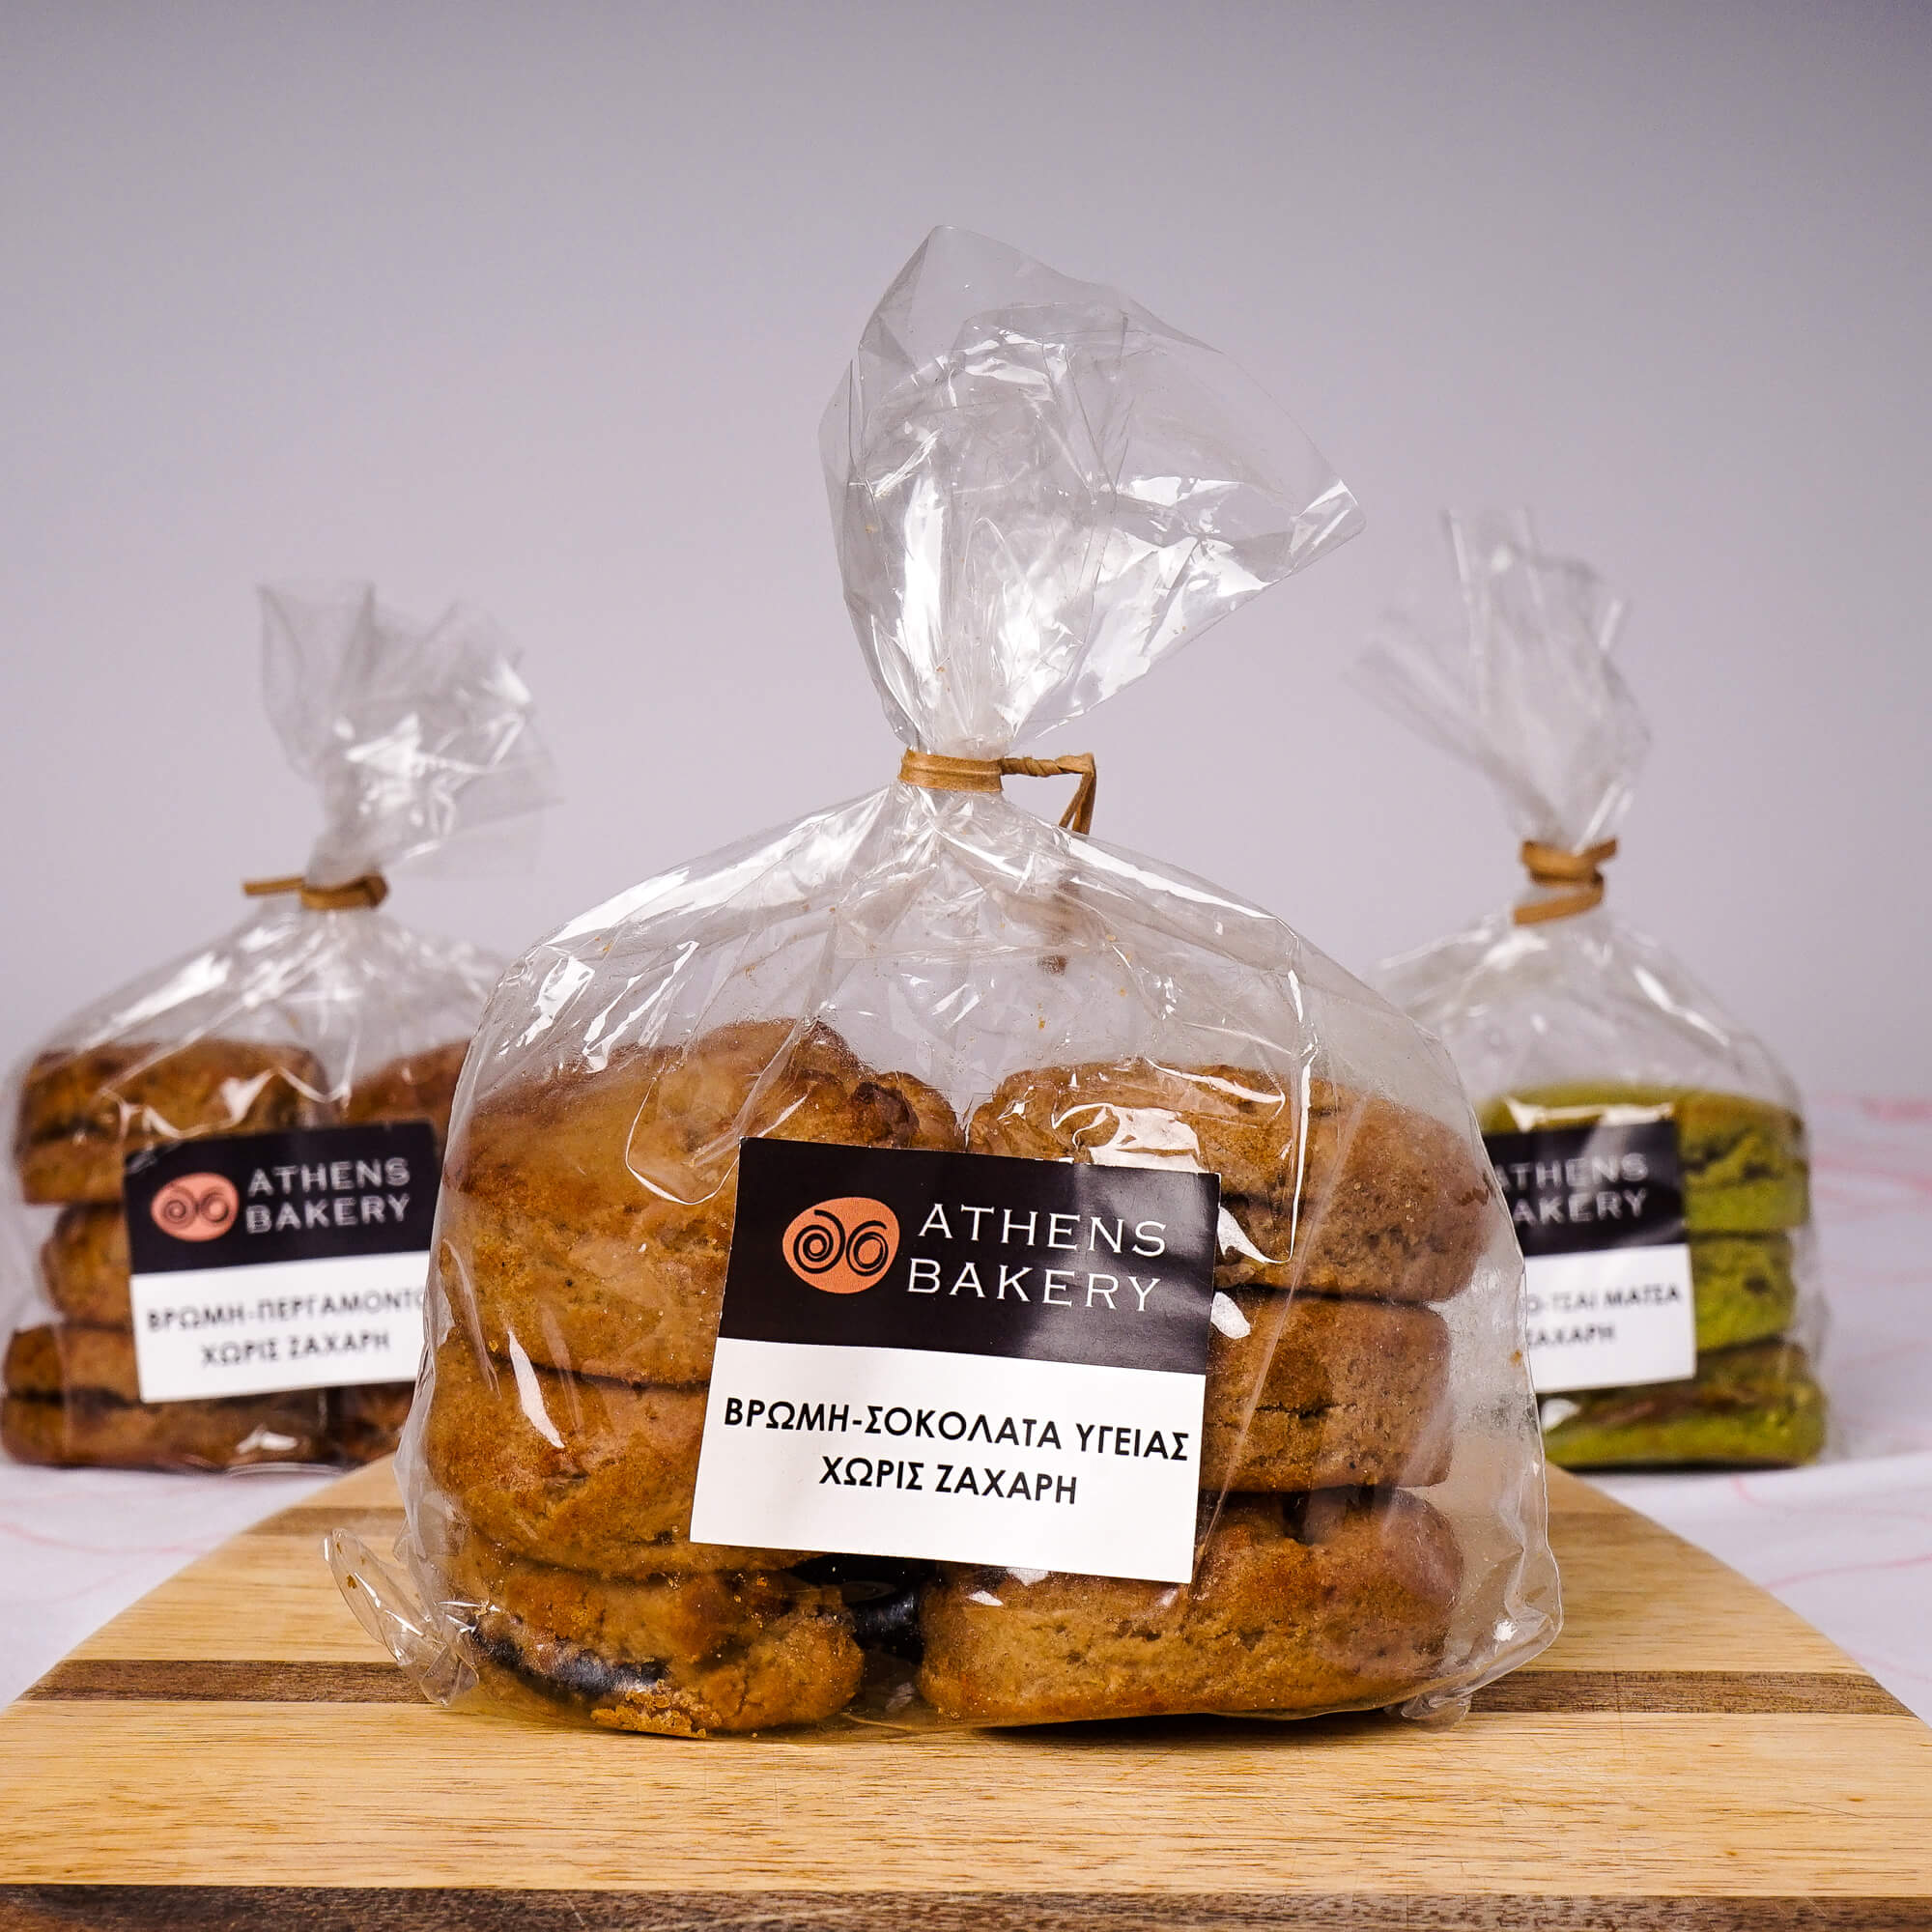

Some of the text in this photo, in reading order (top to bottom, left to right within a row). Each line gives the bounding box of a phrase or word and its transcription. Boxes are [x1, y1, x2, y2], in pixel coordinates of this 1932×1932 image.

[246, 1157, 411, 1197] ATHENS
[245, 1192, 411, 1235] BAKERY
[919, 1203, 1167, 1258] ATHENS
[1513, 1189, 1646, 1226] AKERY
[907, 1258, 1161, 1312] BAKERY
[201, 1329, 390, 1368] ΧΩΡΙΣ ΖΑΧΑΡΗ
[724, 1397, 1189, 1462] ΒΡΩΜΗ-ΣΟΚΟΛΑΤΑ ΥΓΕΙΑΣ
[818, 1456, 1077, 1506] ΧΩΡΙΣ ΖΑΧΑΡΗ
